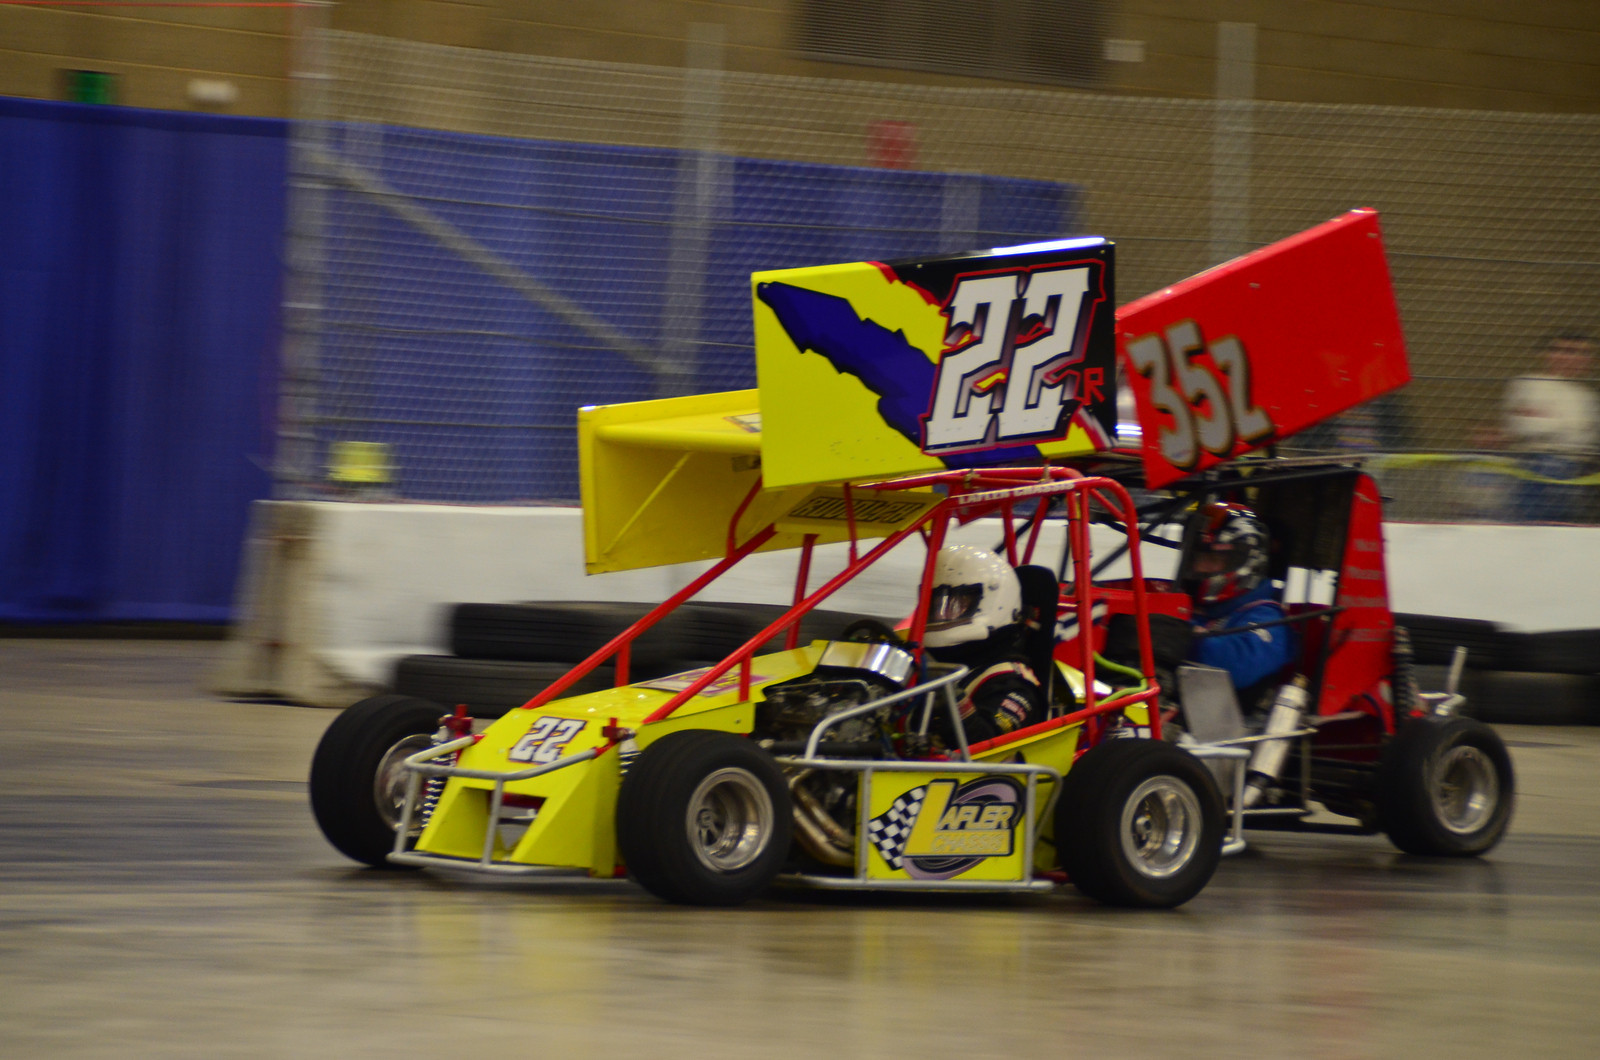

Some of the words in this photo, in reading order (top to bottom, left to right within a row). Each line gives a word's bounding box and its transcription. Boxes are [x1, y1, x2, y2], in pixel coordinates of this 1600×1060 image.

[926, 265, 1090, 448] 22
[1083, 367, 1106, 406] R
[508, 716, 588, 764] 22
